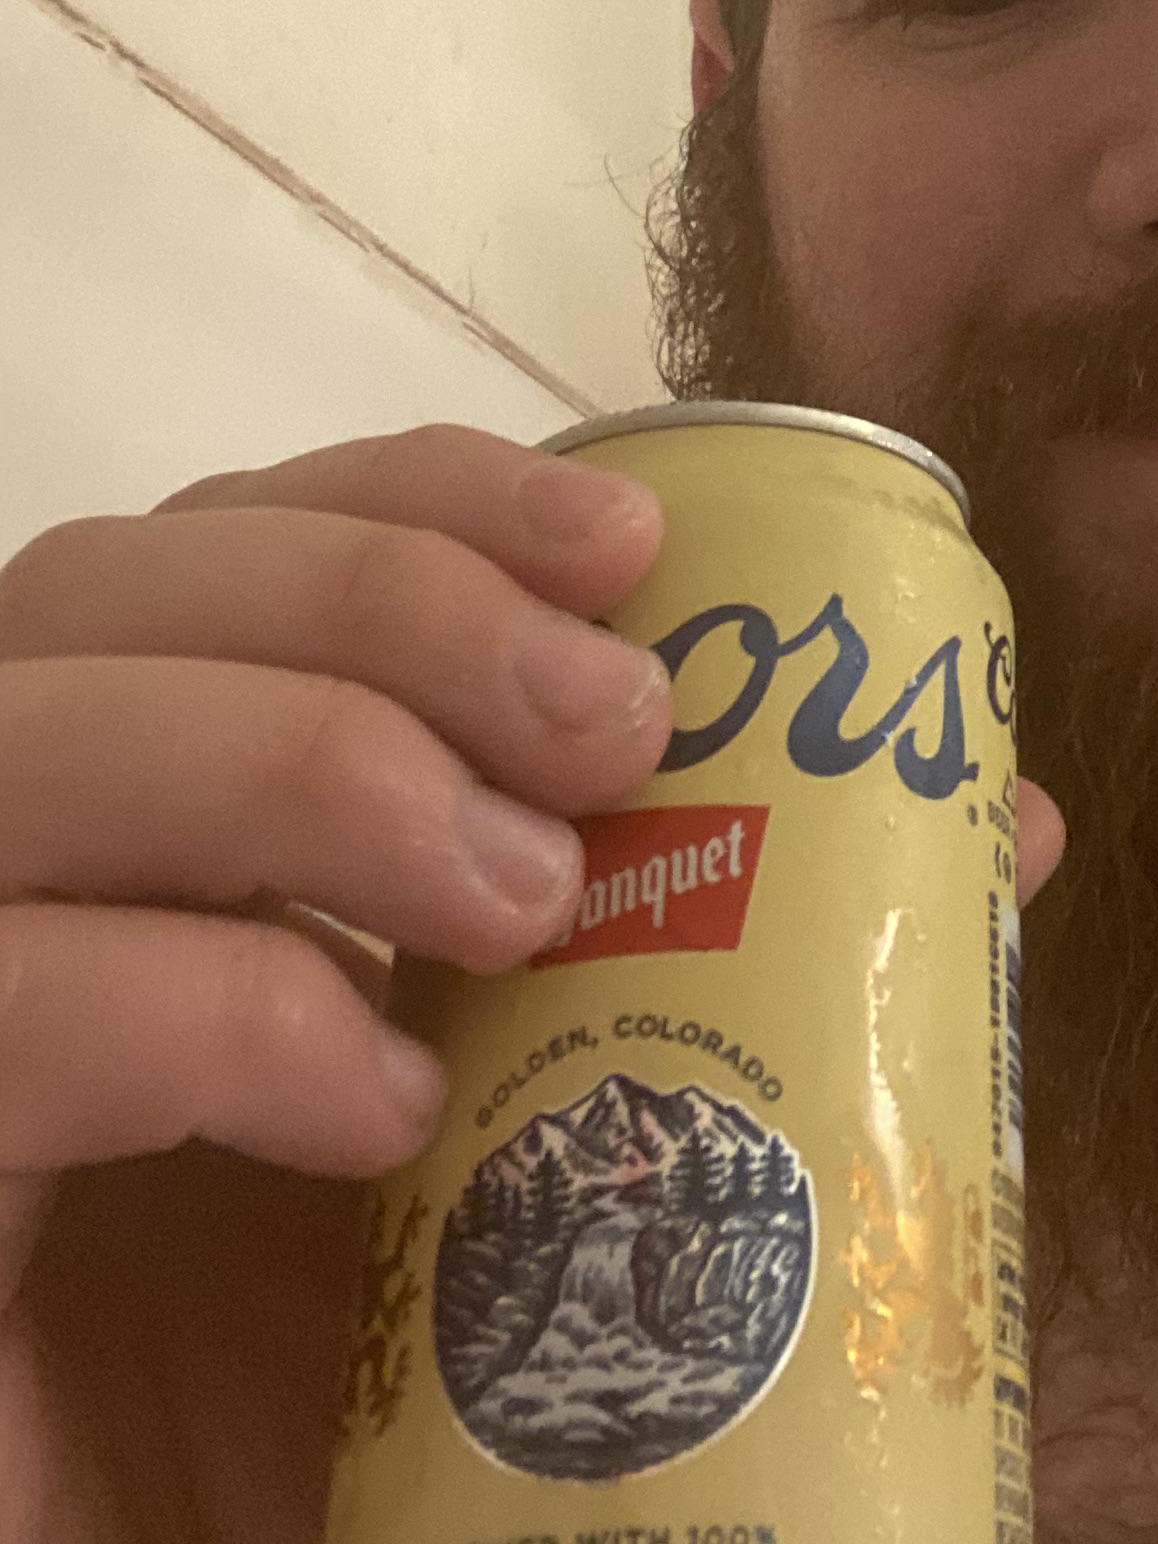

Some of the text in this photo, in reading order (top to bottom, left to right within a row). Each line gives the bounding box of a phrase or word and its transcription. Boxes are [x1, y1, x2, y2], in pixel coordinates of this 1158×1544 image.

[647, 592, 980, 801] ors
[555, 819, 745, 946] anquet
[474, 1014, 784, 1129] GOLDEN, COLORADO
